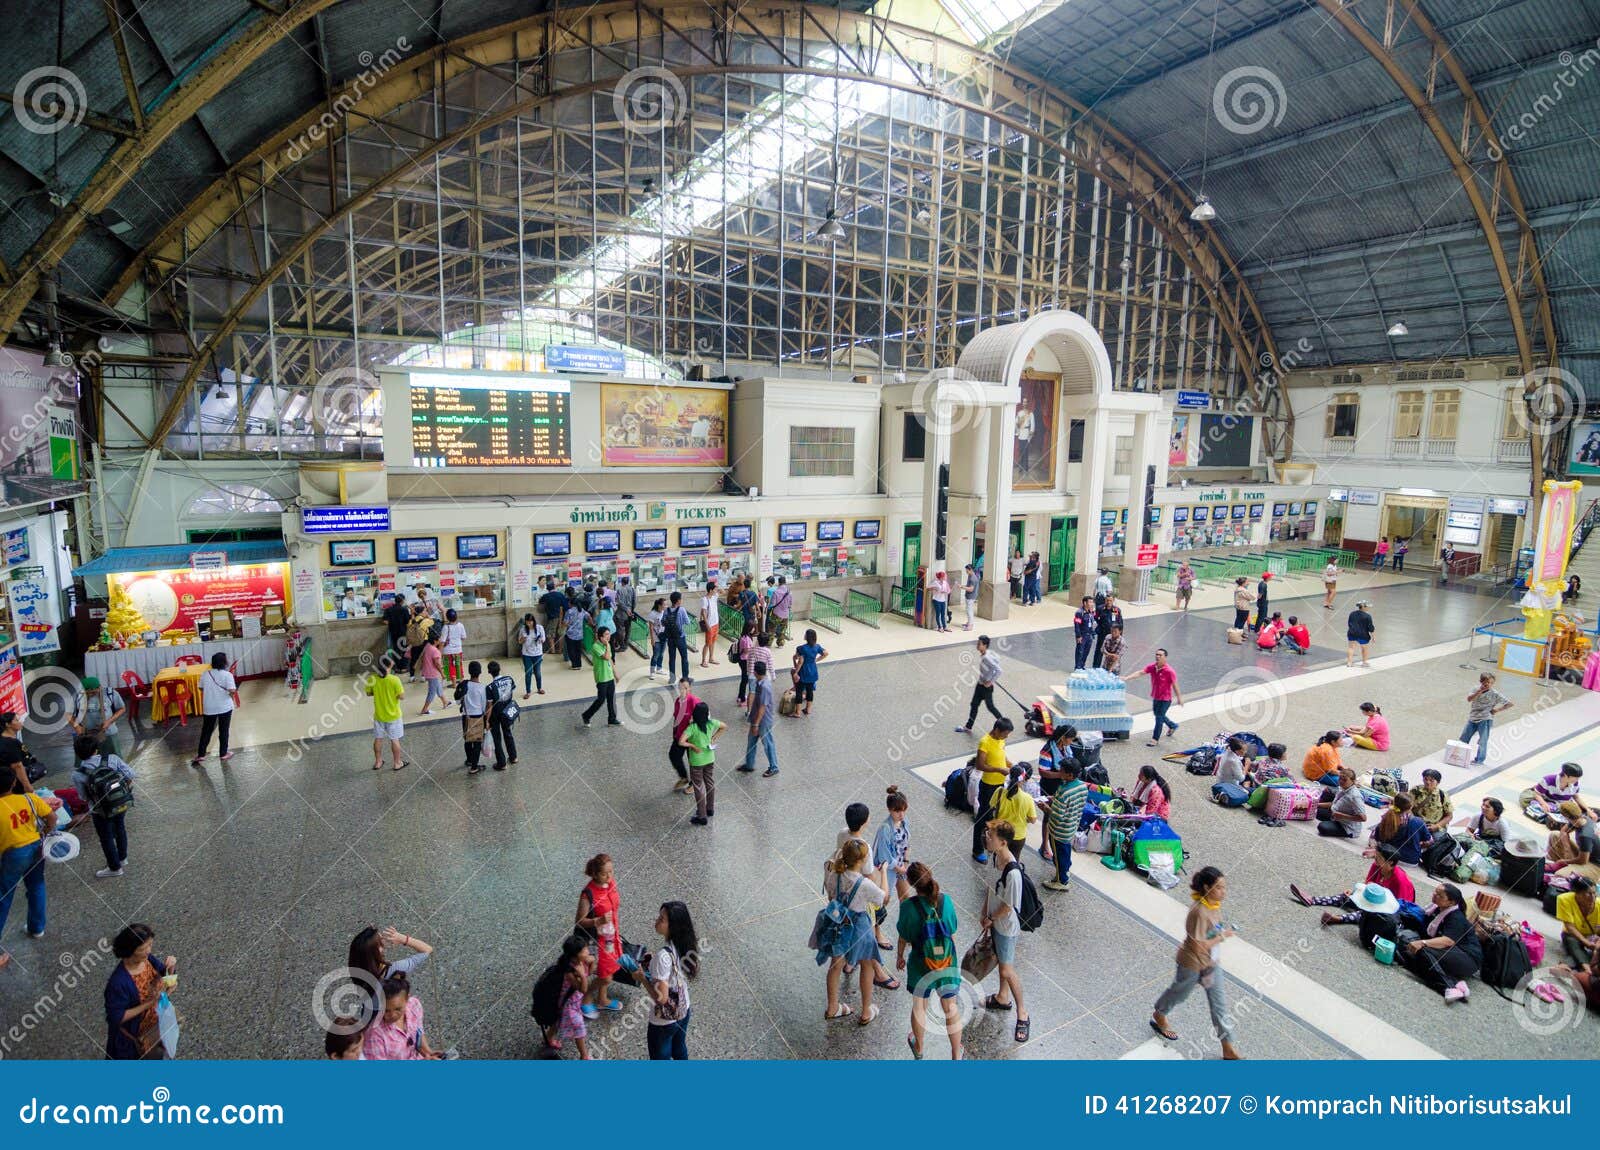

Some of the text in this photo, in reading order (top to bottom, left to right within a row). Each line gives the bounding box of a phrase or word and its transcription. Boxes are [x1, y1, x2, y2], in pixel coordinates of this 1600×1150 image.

[570, 504, 638, 523] จำหน่ายตั๋ว
[675, 507, 727, 519] TICKETS
